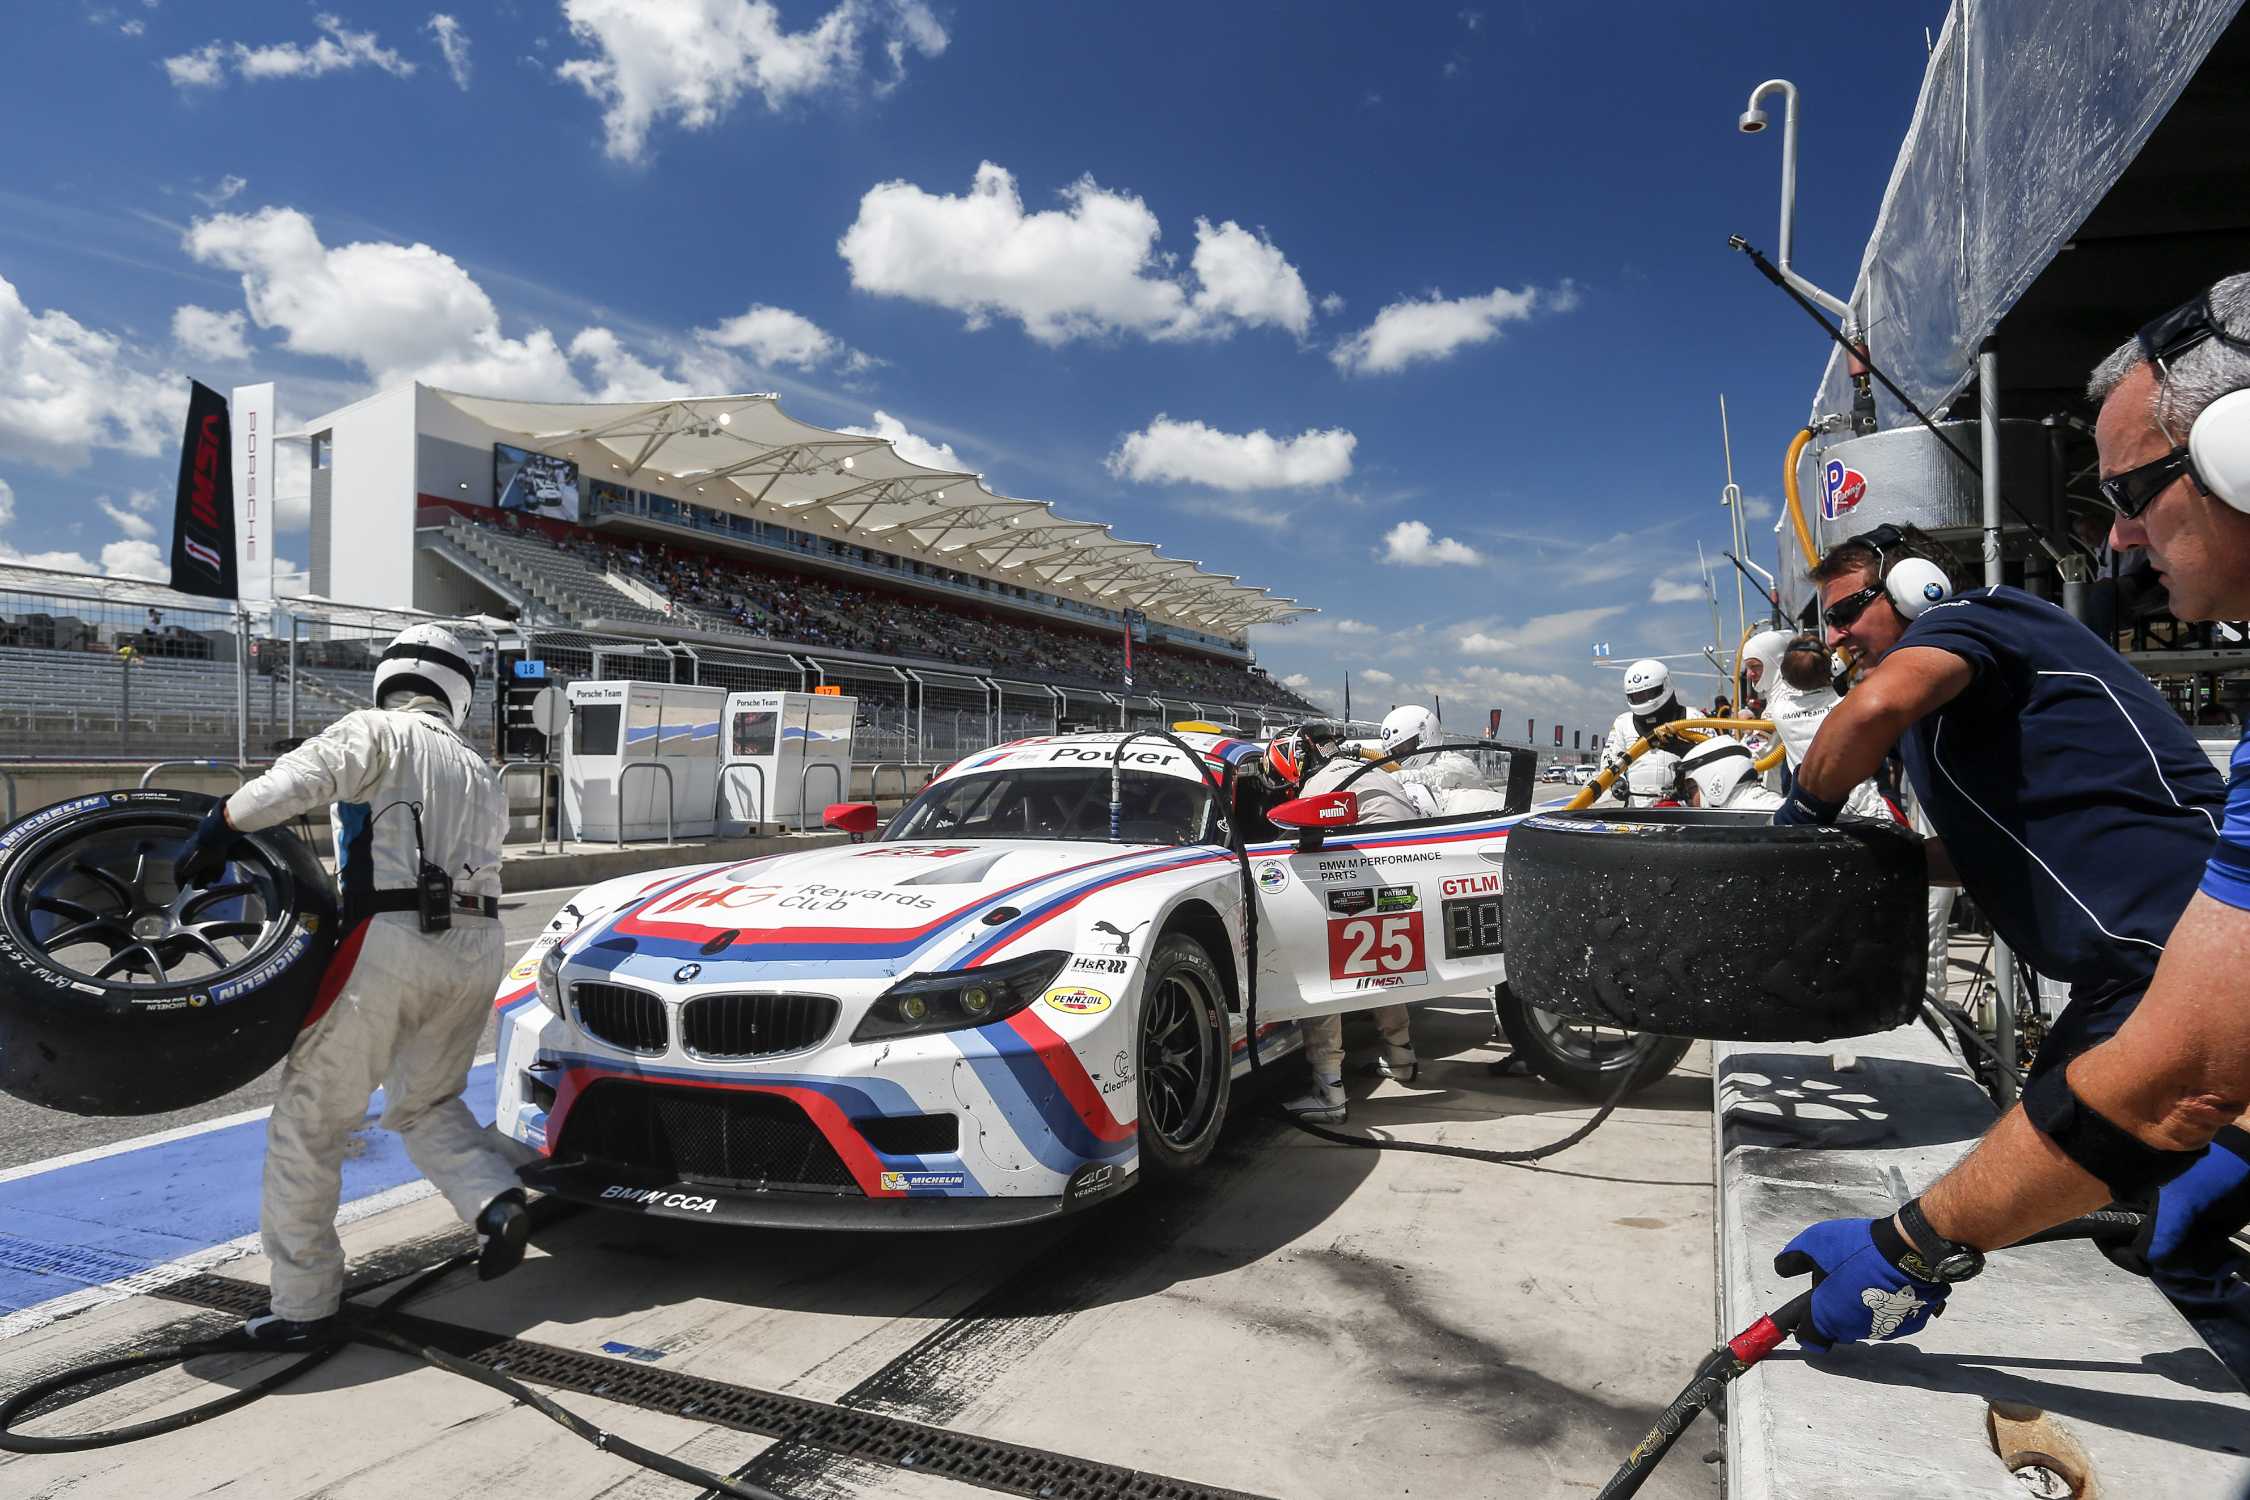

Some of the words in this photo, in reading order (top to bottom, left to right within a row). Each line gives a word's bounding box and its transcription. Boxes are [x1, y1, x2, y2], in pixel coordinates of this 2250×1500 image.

[248, 411, 256, 561] PORSCHE
[1592, 642, 1610, 656] 11
[523, 664, 535, 674] 18
[576, 689, 602, 698] Porsche
[604, 688, 622, 697] Team
[736, 699, 761, 707] Porsche
[762, 698, 778, 706] Team
[1783, 711, 1801, 720] BMW
[1802, 708, 1825, 717] Team
[1048, 748, 1181, 766] Power
[1320, 808, 1345, 818] PUMA
[2, 797, 100, 847] MICHELIN
[1319, 860, 1346, 871] BMW
[1348, 859, 1358, 868] M
[1360, 852, 1443, 867] PERFORMANCE
[1321, 870, 1357, 881] PARTS
[1442, 875, 1499, 895] GTLM
[778, 896, 848, 911] Club
[798, 884, 937, 910] Rewards
[1343, 917, 1413, 975] 25
[220, 939, 305, 1001] MICHELIN
[1074, 958, 1106, 970] H&R
[1372, 976, 1404, 987] IMSA
[1052, 995, 1102, 1005] PENNZOIL
[601, 1185, 666, 1204] BMW
[663, 1193, 718, 1213] CCA
